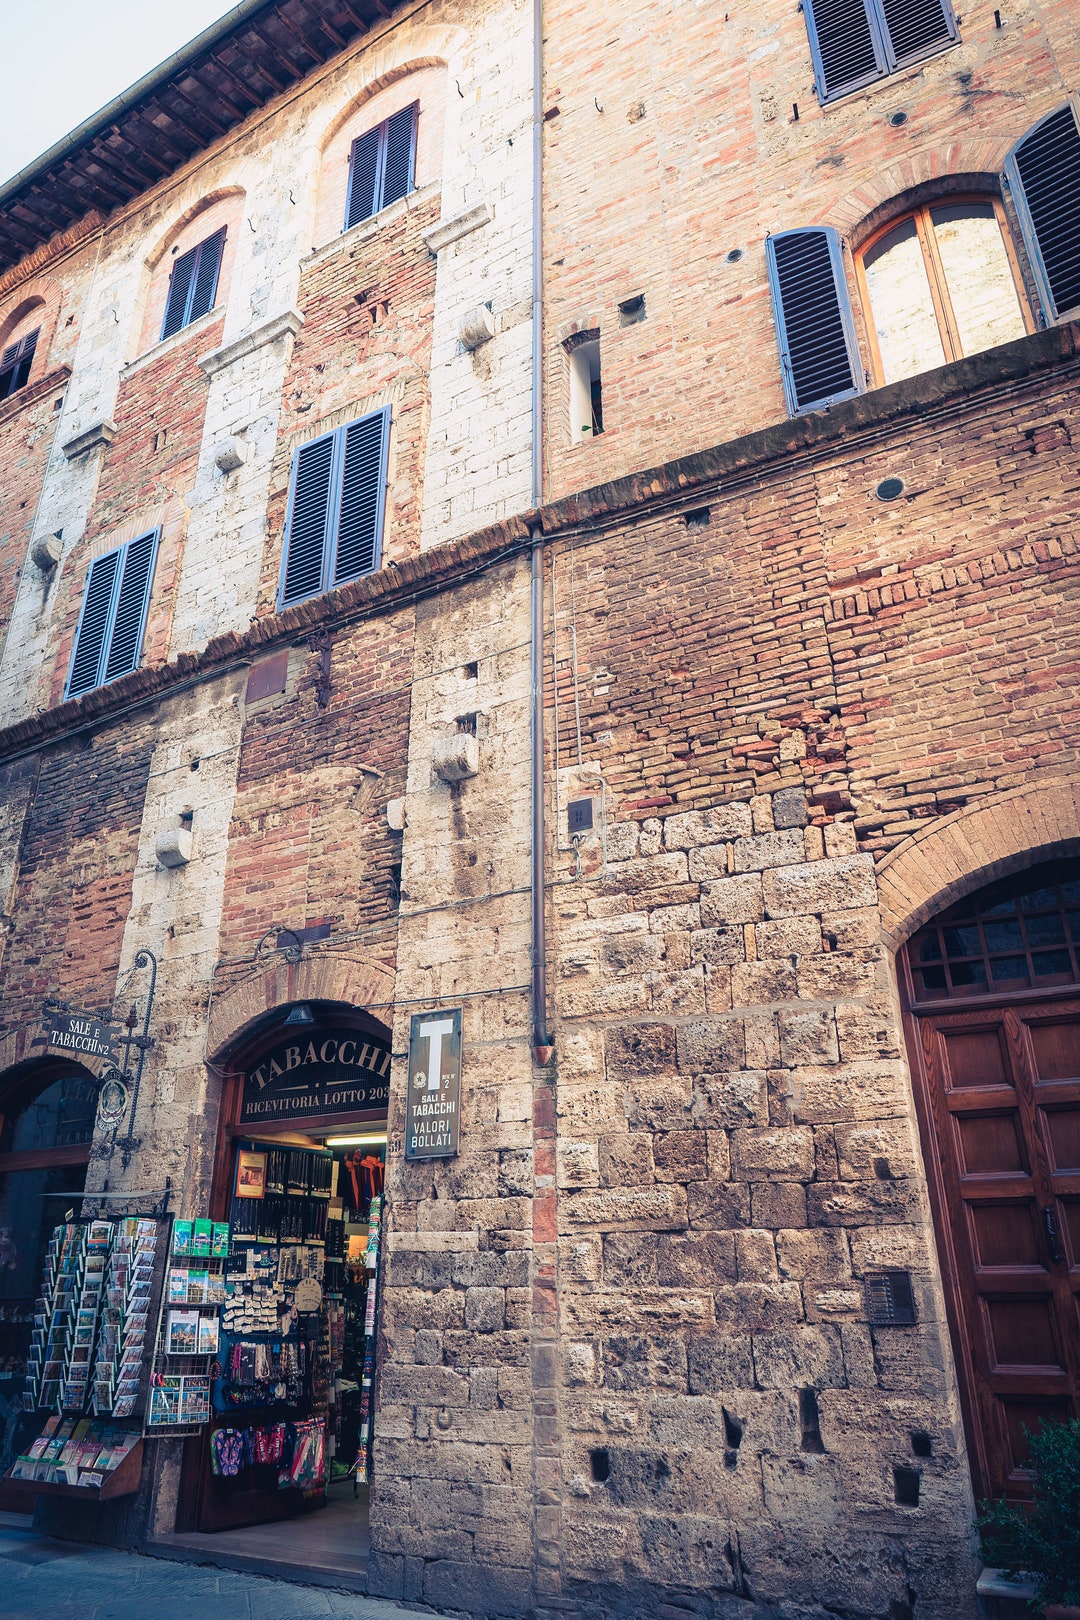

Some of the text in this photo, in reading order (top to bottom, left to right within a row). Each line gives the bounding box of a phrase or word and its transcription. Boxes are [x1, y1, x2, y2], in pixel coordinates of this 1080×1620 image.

[69, 1020, 101, 1038] SALE E
[51, 1030, 98, 1052] TABACCHI
[420, 1018, 454, 1091] T
[250, 1039, 392, 1091] TABACCHI
[444, 1079, 450, 1089] 2
[246, 1086, 391, 1114] RICEVITORIA LOTTO 203
[421, 1093, 446, 1104] SALI E
[412, 1101, 455, 1116] TABACCHI
[414, 1120, 450, 1134] VALORI
[411, 1133, 451, 1148] BOLLATI
